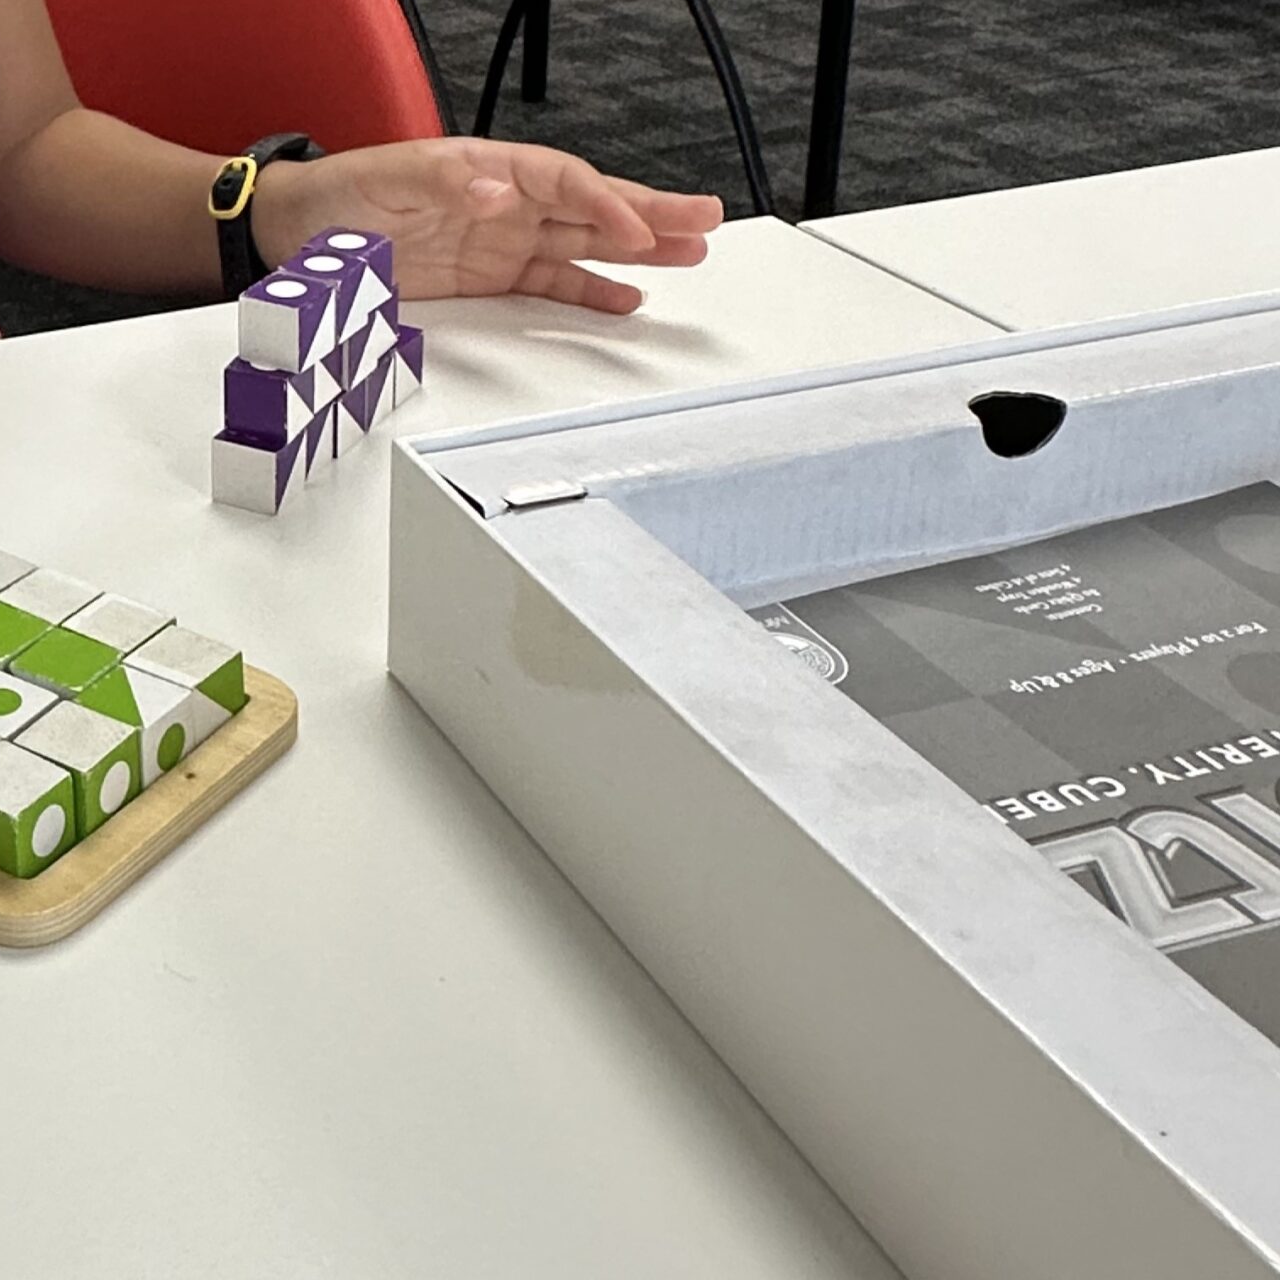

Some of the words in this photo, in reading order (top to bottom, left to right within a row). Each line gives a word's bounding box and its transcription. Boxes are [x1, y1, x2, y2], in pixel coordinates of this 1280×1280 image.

[1027, 581, 1077, 596] Wooden
[1219, 629, 1235, 638] 2
[1233, 621, 1268, 635] For
[1184, 636, 1200, 647] 4
[1200, 633, 1224, 643] to
[1128, 641, 1194, 661] Players
[1069, 659, 1116, 678] Ages
[1032, 675, 1060, 688] &
[1055, 671, 1074, 684] 8
[1008, 679, 1043, 693] Up
[982, 776, 1126, 824] CUBE
